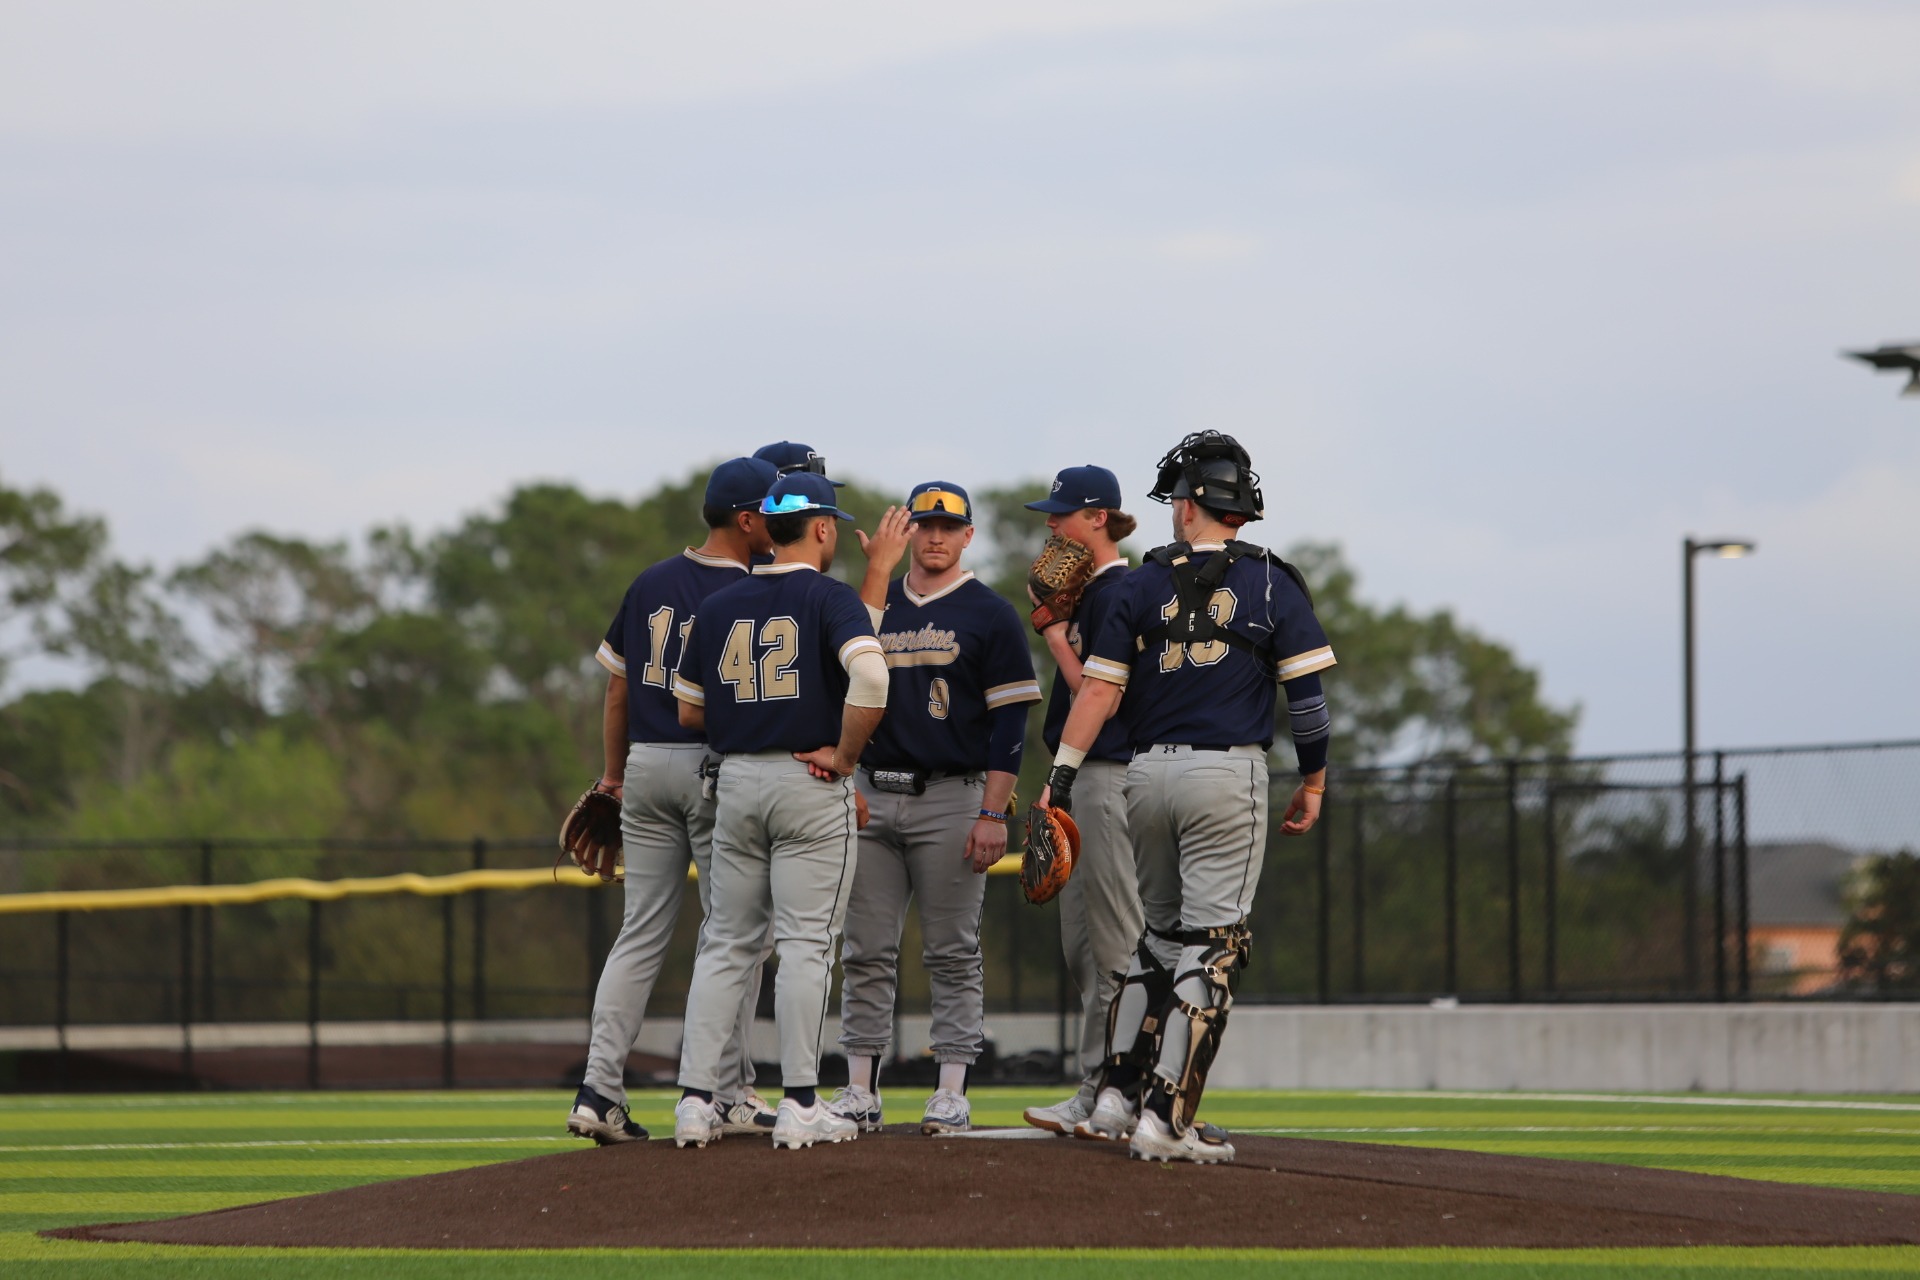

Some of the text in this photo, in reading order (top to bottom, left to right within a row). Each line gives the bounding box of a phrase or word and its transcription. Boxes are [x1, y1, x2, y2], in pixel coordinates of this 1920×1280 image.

[879, 621, 957, 653] rnerstone
[718, 615, 800, 703] 42
[928, 677, 950, 720] 9
